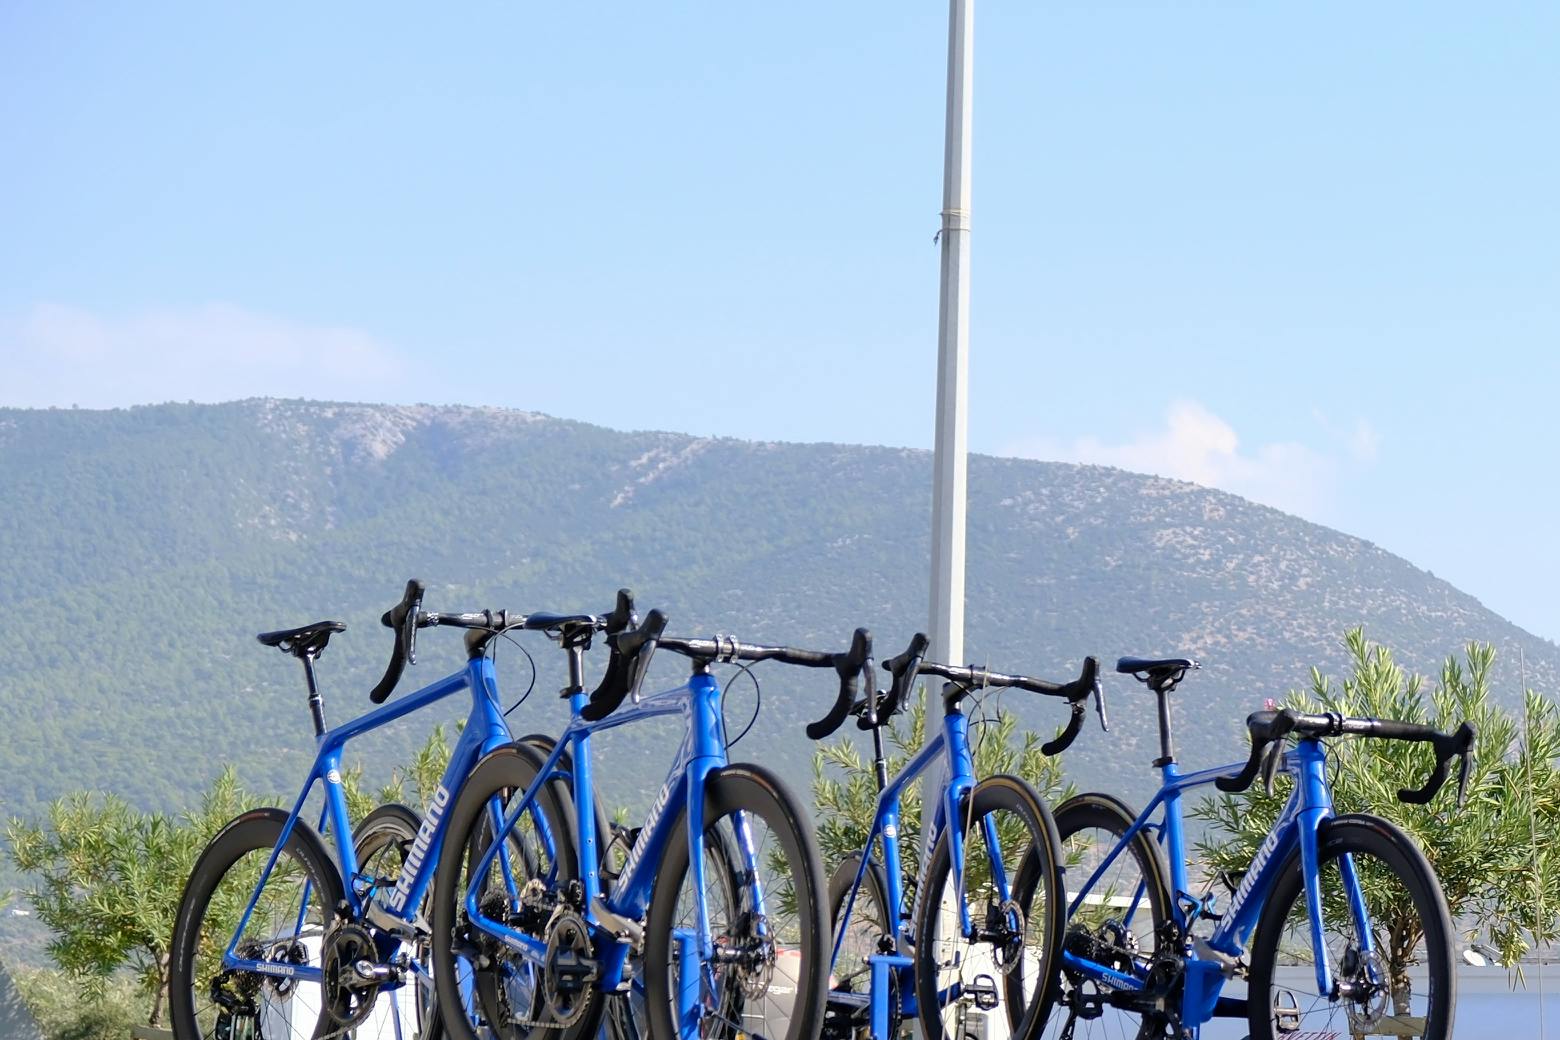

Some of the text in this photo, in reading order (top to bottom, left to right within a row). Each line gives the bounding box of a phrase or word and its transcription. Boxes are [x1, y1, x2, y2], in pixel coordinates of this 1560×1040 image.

[390, 784, 449, 912] SHIMANO
[1221, 831, 1278, 932] SHIMANO
[256, 963, 294, 976] SHIMANO
[1102, 972, 1139, 991] SHIMAN
